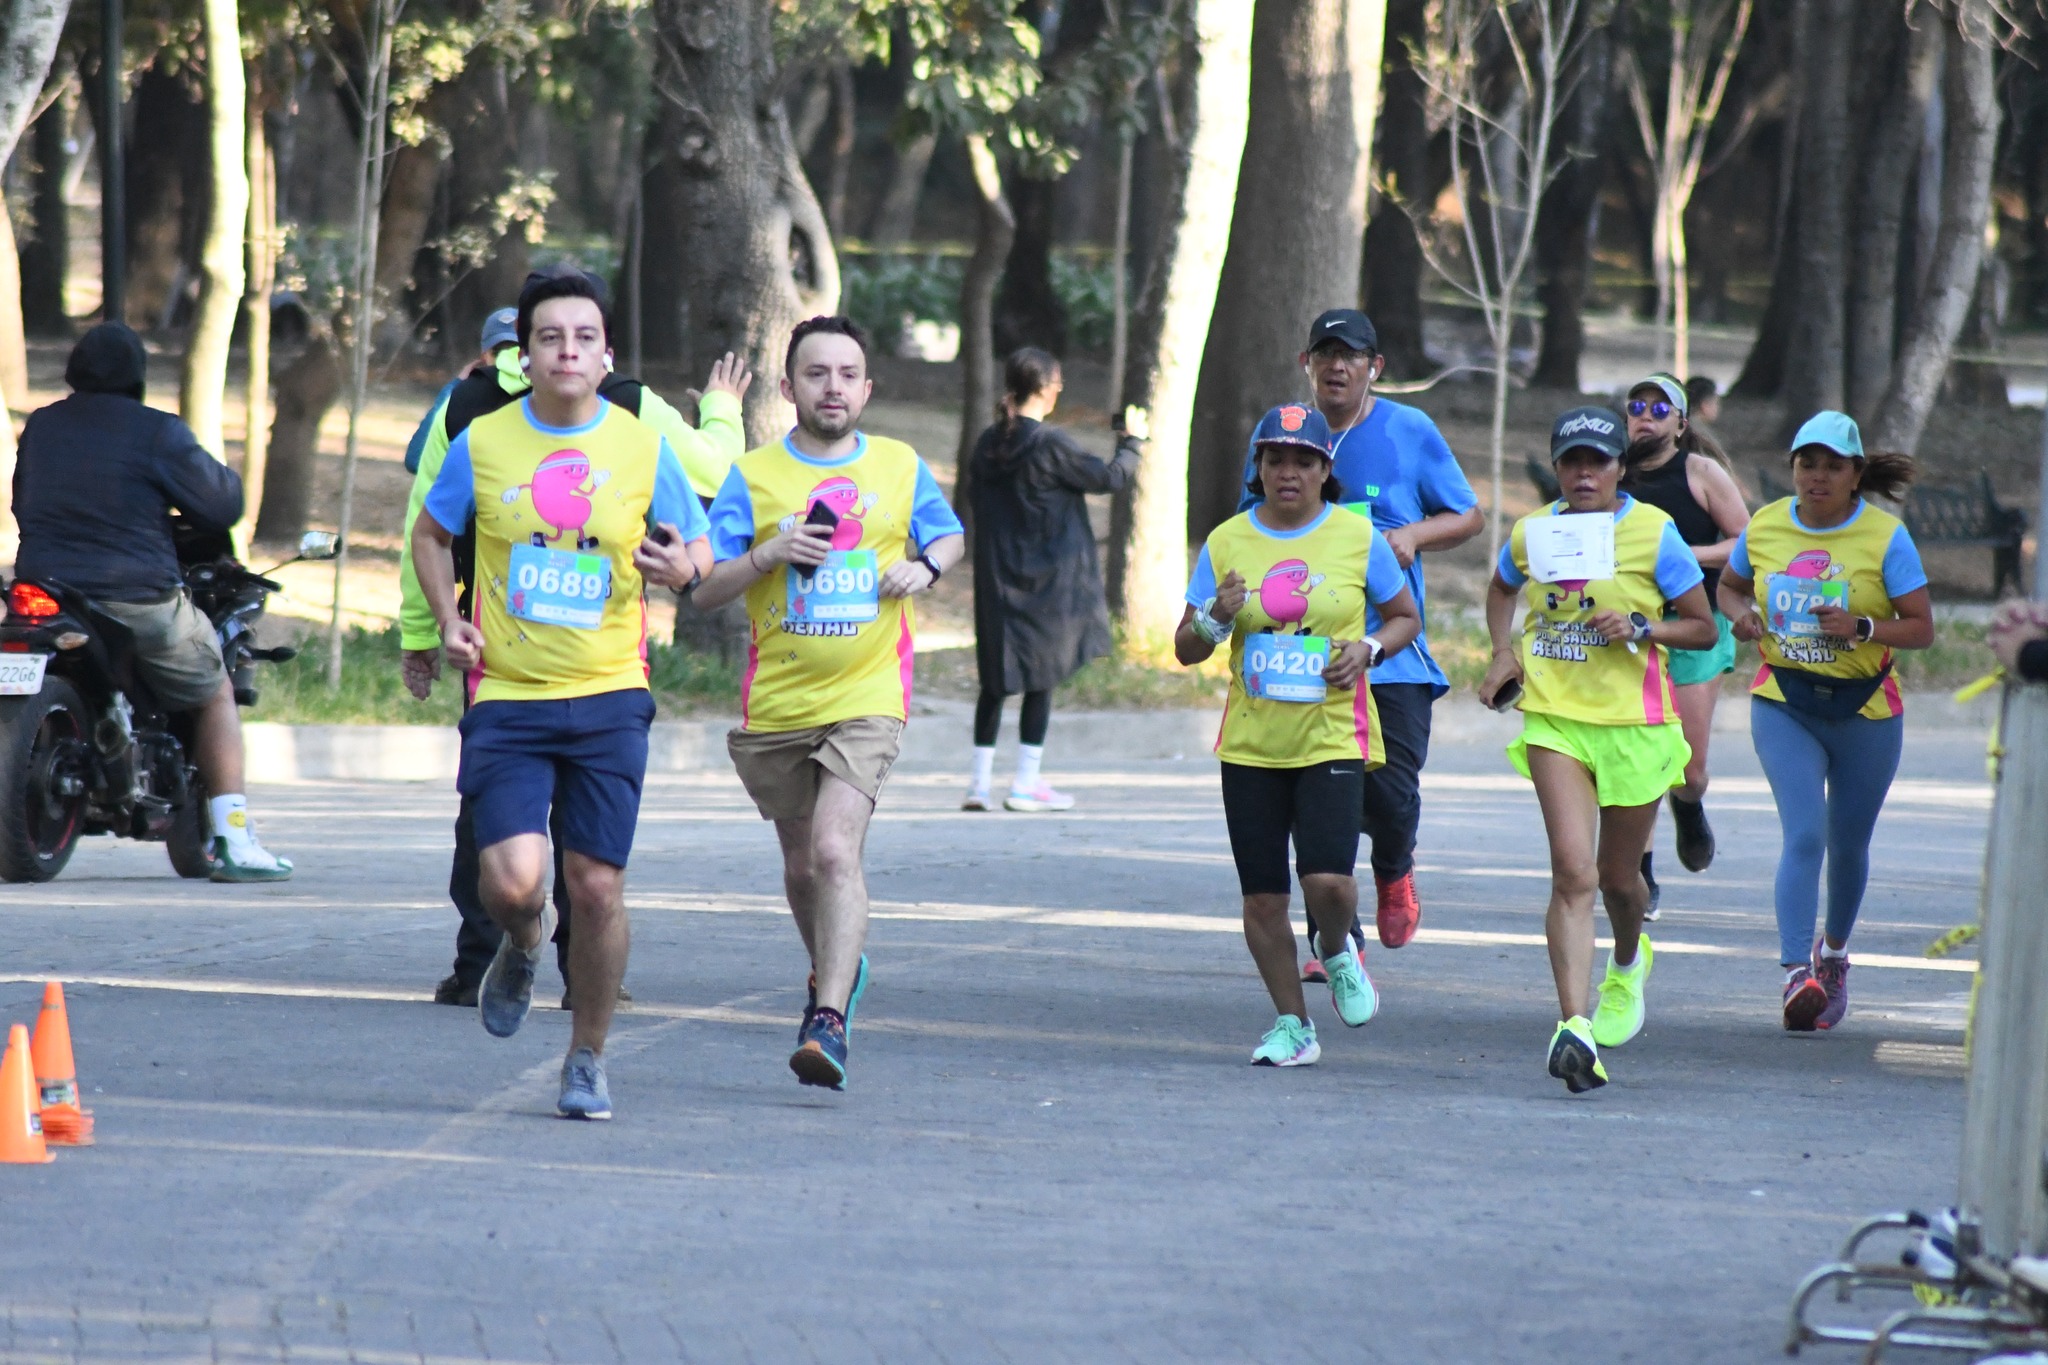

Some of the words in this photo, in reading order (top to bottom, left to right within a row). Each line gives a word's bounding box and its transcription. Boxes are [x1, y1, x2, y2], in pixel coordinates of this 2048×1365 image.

[518, 563, 602, 600] 0689
[795, 567, 874, 595] 0690
[1532, 640, 1587, 662] RENAL
[1563, 633, 1610, 647] SALUD
[1251, 650, 1325, 676] 0420
